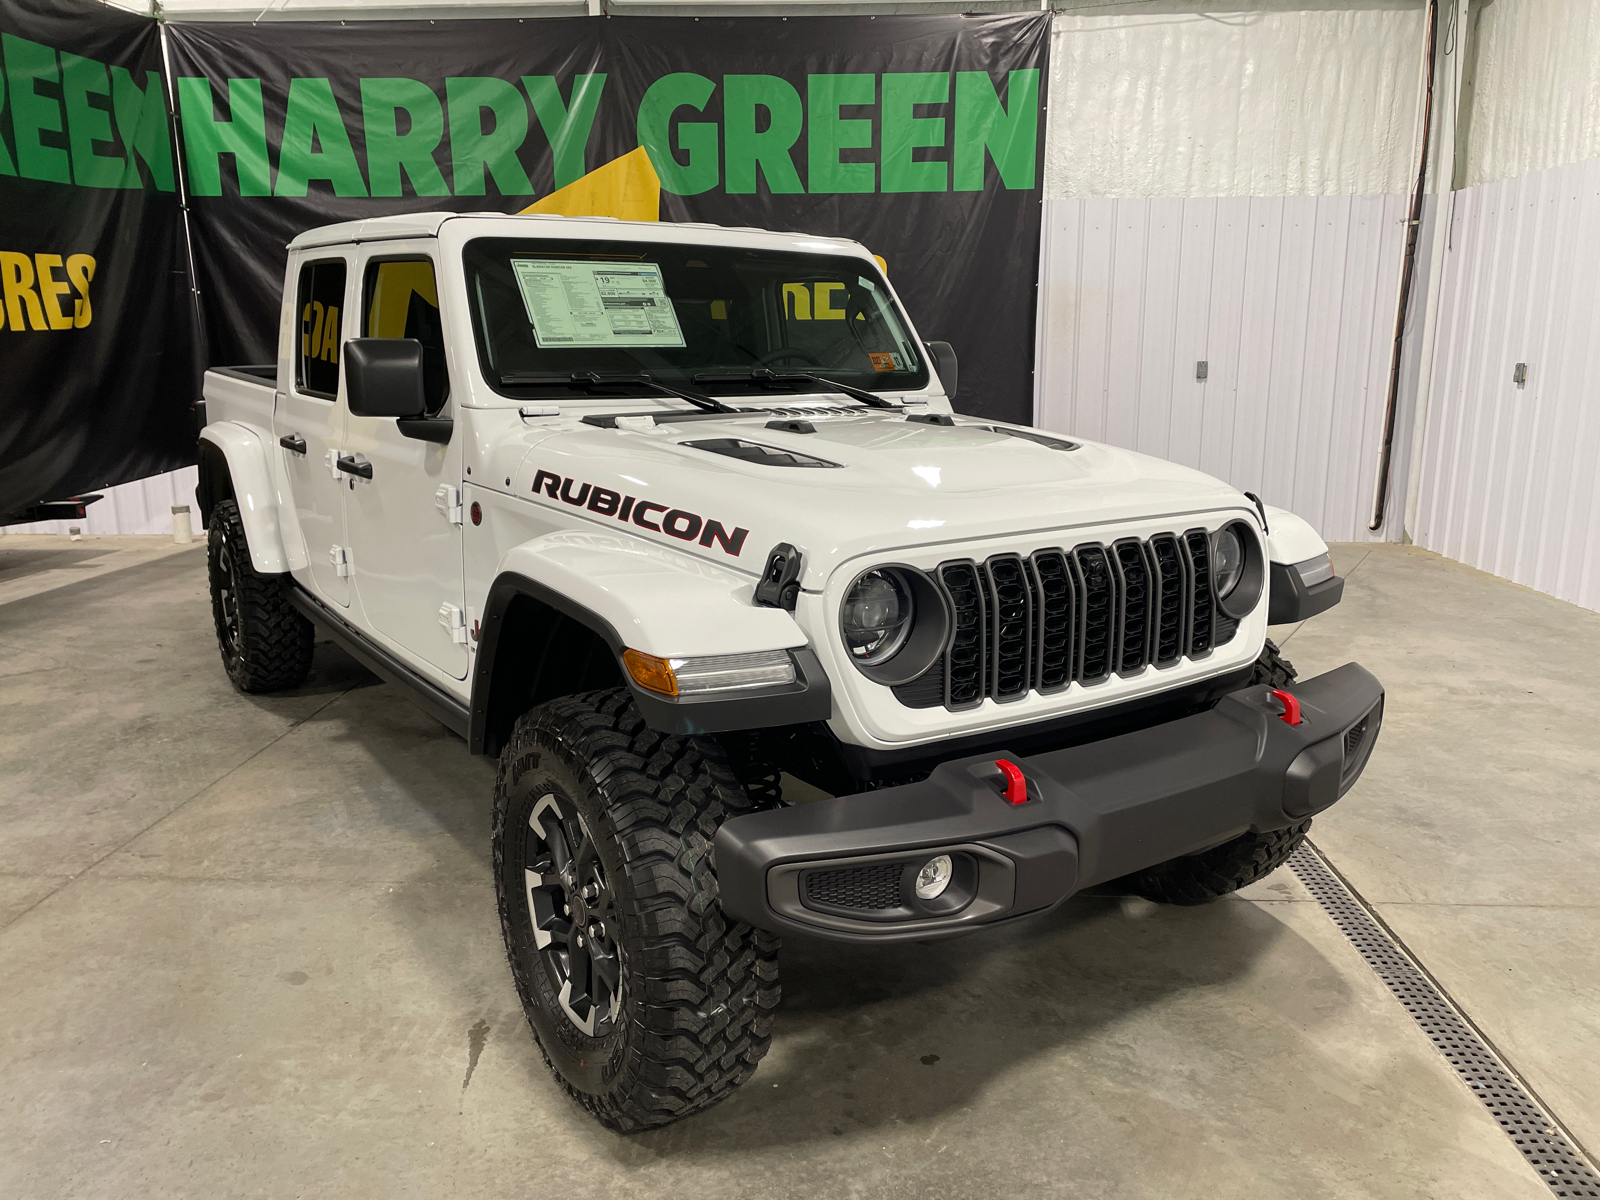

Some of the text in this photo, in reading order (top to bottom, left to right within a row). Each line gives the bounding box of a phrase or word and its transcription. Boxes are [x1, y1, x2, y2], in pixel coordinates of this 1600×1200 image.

[177, 69, 1039, 197] HARRY GREEN
[0, 251, 96, 331] RES
[531, 468, 750, 558] RUBICON
